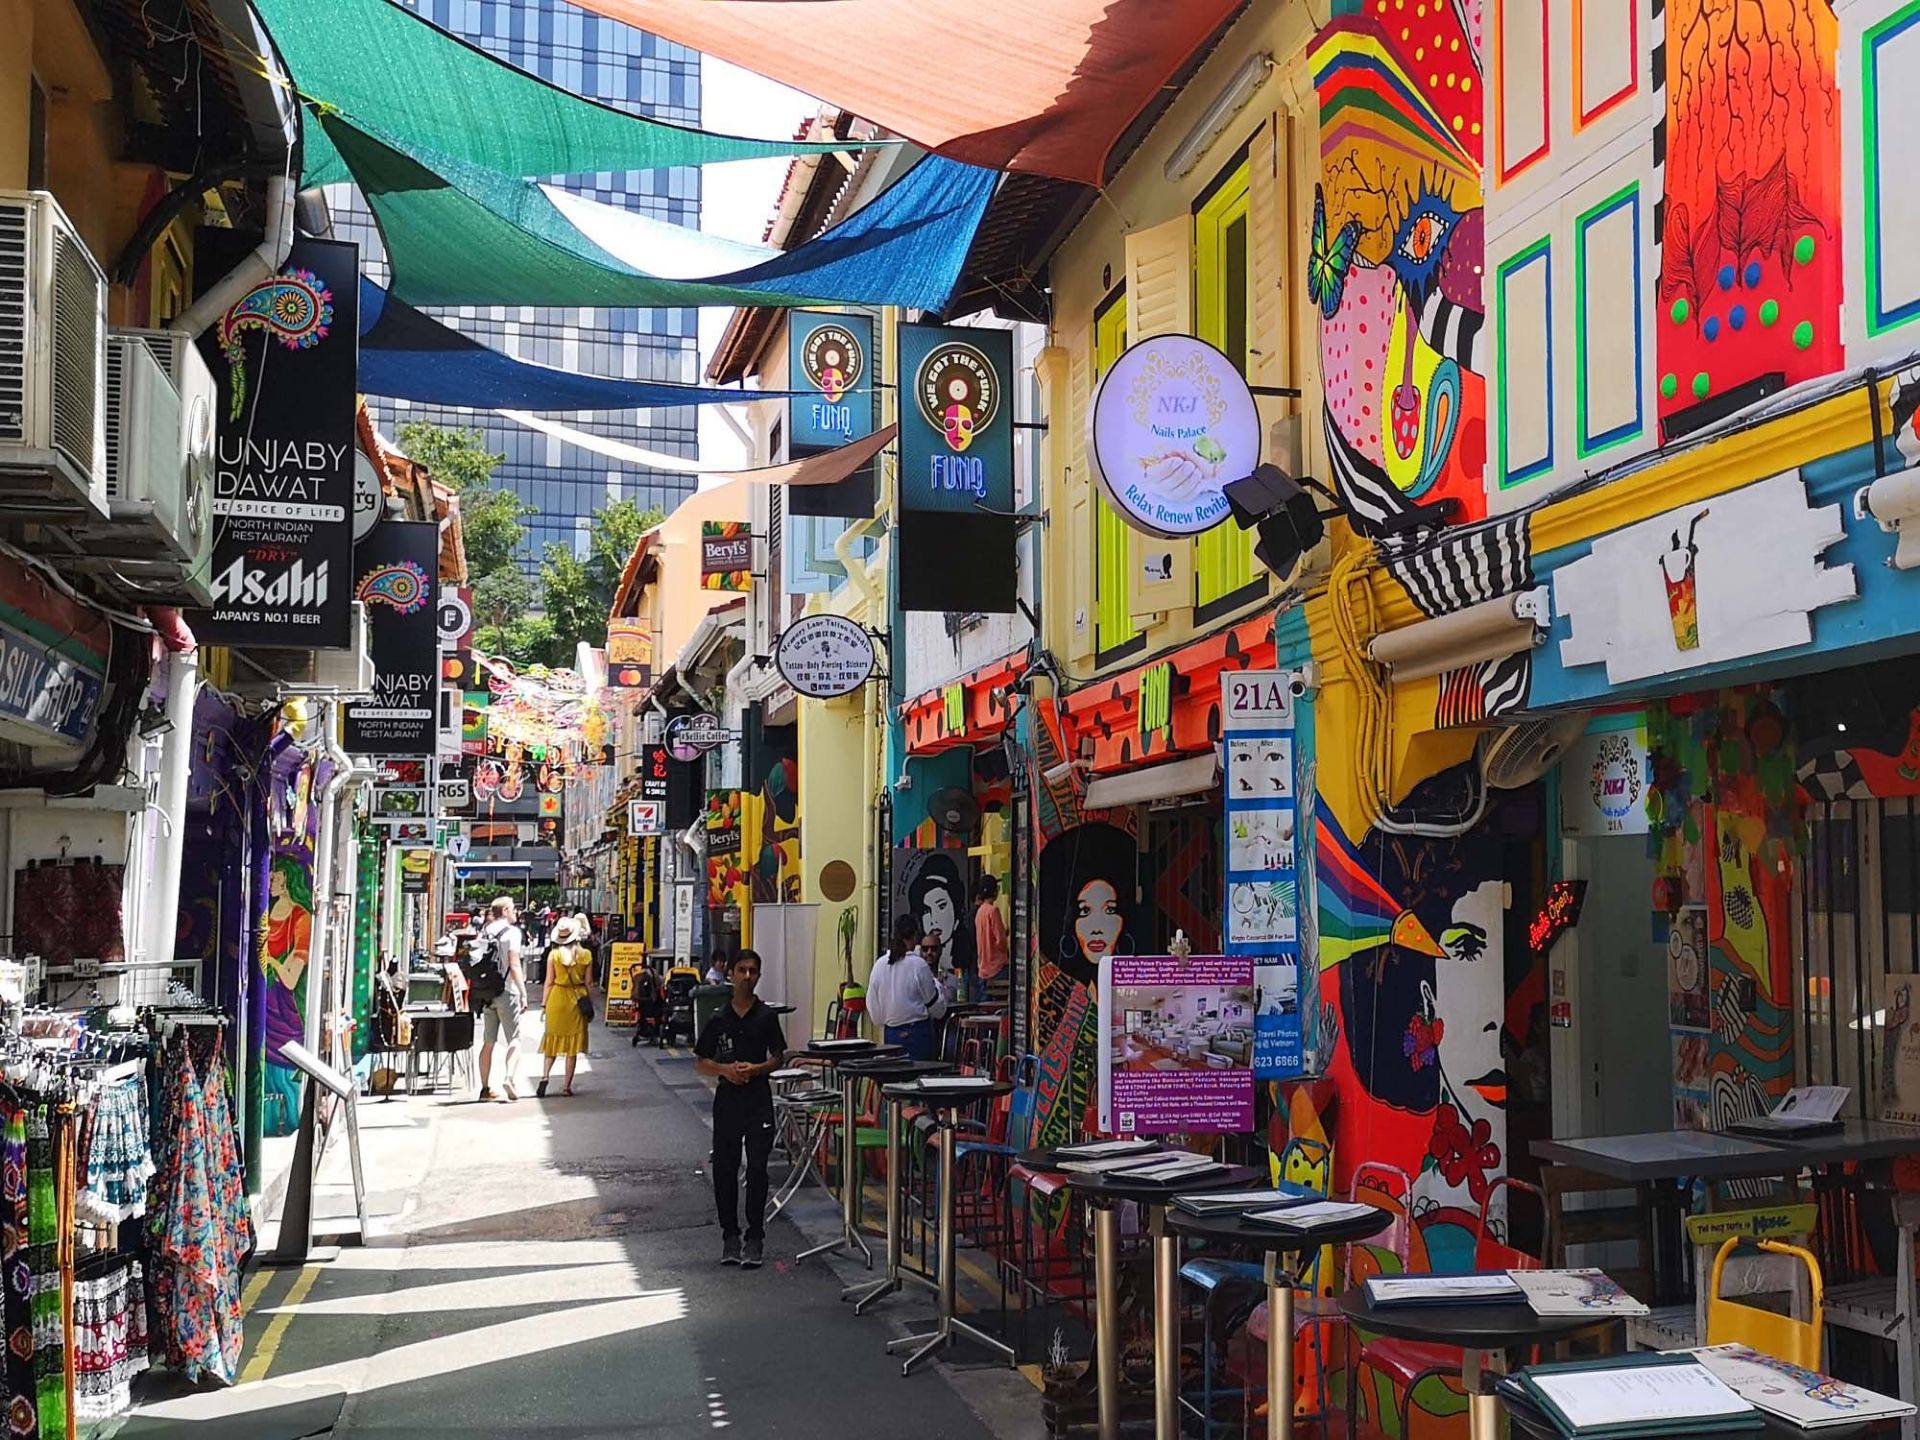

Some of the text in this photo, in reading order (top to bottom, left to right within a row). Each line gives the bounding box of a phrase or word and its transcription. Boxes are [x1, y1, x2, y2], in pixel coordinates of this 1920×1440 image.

[809, 331, 857, 375] WE GOT THE FUNK
[926, 353, 992, 413] WE GOT THE FUNK
[1150, 422, 1207, 440] Nails Palace
[218, 434, 348, 473] UNJABY
[217, 470, 326, 500] DAWAT
[212, 501, 341, 519] HE SPICE OF LIFE
[1124, 483, 1229, 525] Relax Renew Revita
[228, 519, 314, 534] NORTH INDIAN
[231, 530, 310, 544] RESTAURANT
[705, 541, 747, 559] Beryl's
[210, 555, 329, 608] Asahi
[212, 610, 321, 625] JAPAN'S NO.1 BEER
[443, 609, 457, 628] F
[780, 618, 870, 653] Memory Lane Tattoo Studio
[785, 661, 804, 670] Tattoo
[806, 661, 819, 671] Body
[821, 660, 842, 671] Piercing
[1, 646, 46, 709] SILK
[375, 673, 433, 695] NJABY
[1233, 681, 1285, 711] 21A
[357, 721, 424, 731] NORTH INDIAN
[360, 729, 421, 739] RESTAURANT
[437, 784, 466, 798] RGS
[1603, 778, 1627, 796] NKJ
[709, 830, 740, 846] Beryl's
[1257, 1029, 1299, 1038] Travel Photos
[1271, 1038, 1295, 1047] Vietnam
[1254, 1055, 1299, 1068] 623 6866
